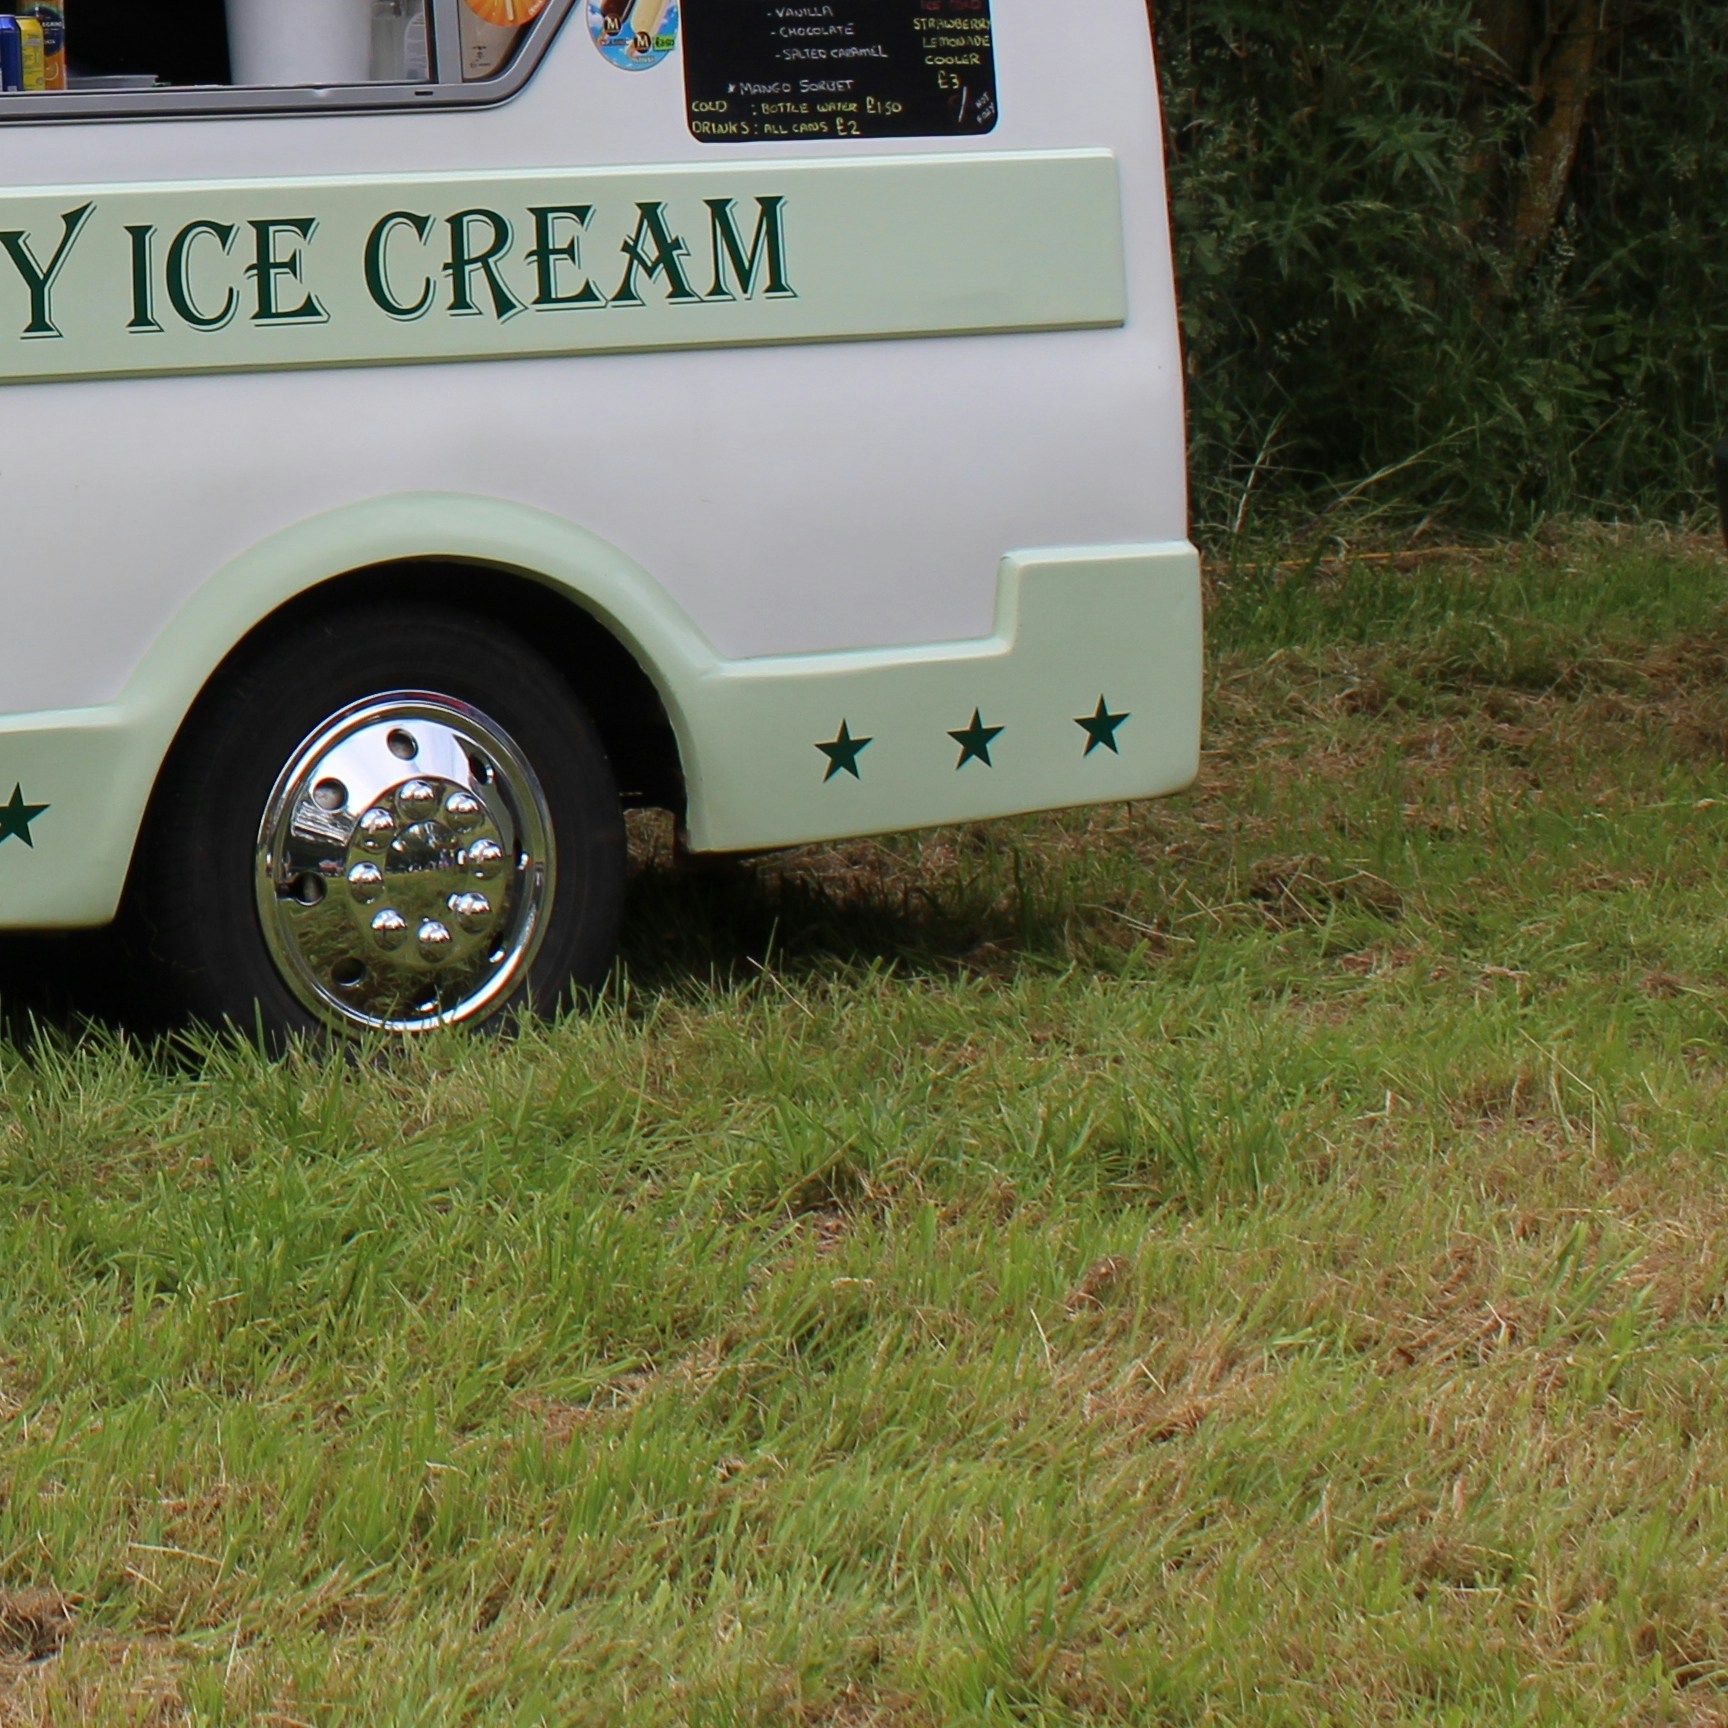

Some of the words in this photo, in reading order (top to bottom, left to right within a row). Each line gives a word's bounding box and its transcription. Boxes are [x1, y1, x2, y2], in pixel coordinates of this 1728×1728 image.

[775, 5, 834, 18] VANILLA
[780, 23, 855, 38] CHOCOLATE
[925, 52, 981, 65] COOLER
[739, 81, 791, 95] MANGO
[800, 78, 855, 93] SORBET
[937, 70, 959, 89] £3
[692, 100, 728, 113] COLD
[761, 102, 809, 114] BOTTLE
[764, 123, 789, 134] ALL
[836, 117, 861, 136] £2
[126, 216, 331, 335] ICE
[362, 195, 799, 324] CREAM
